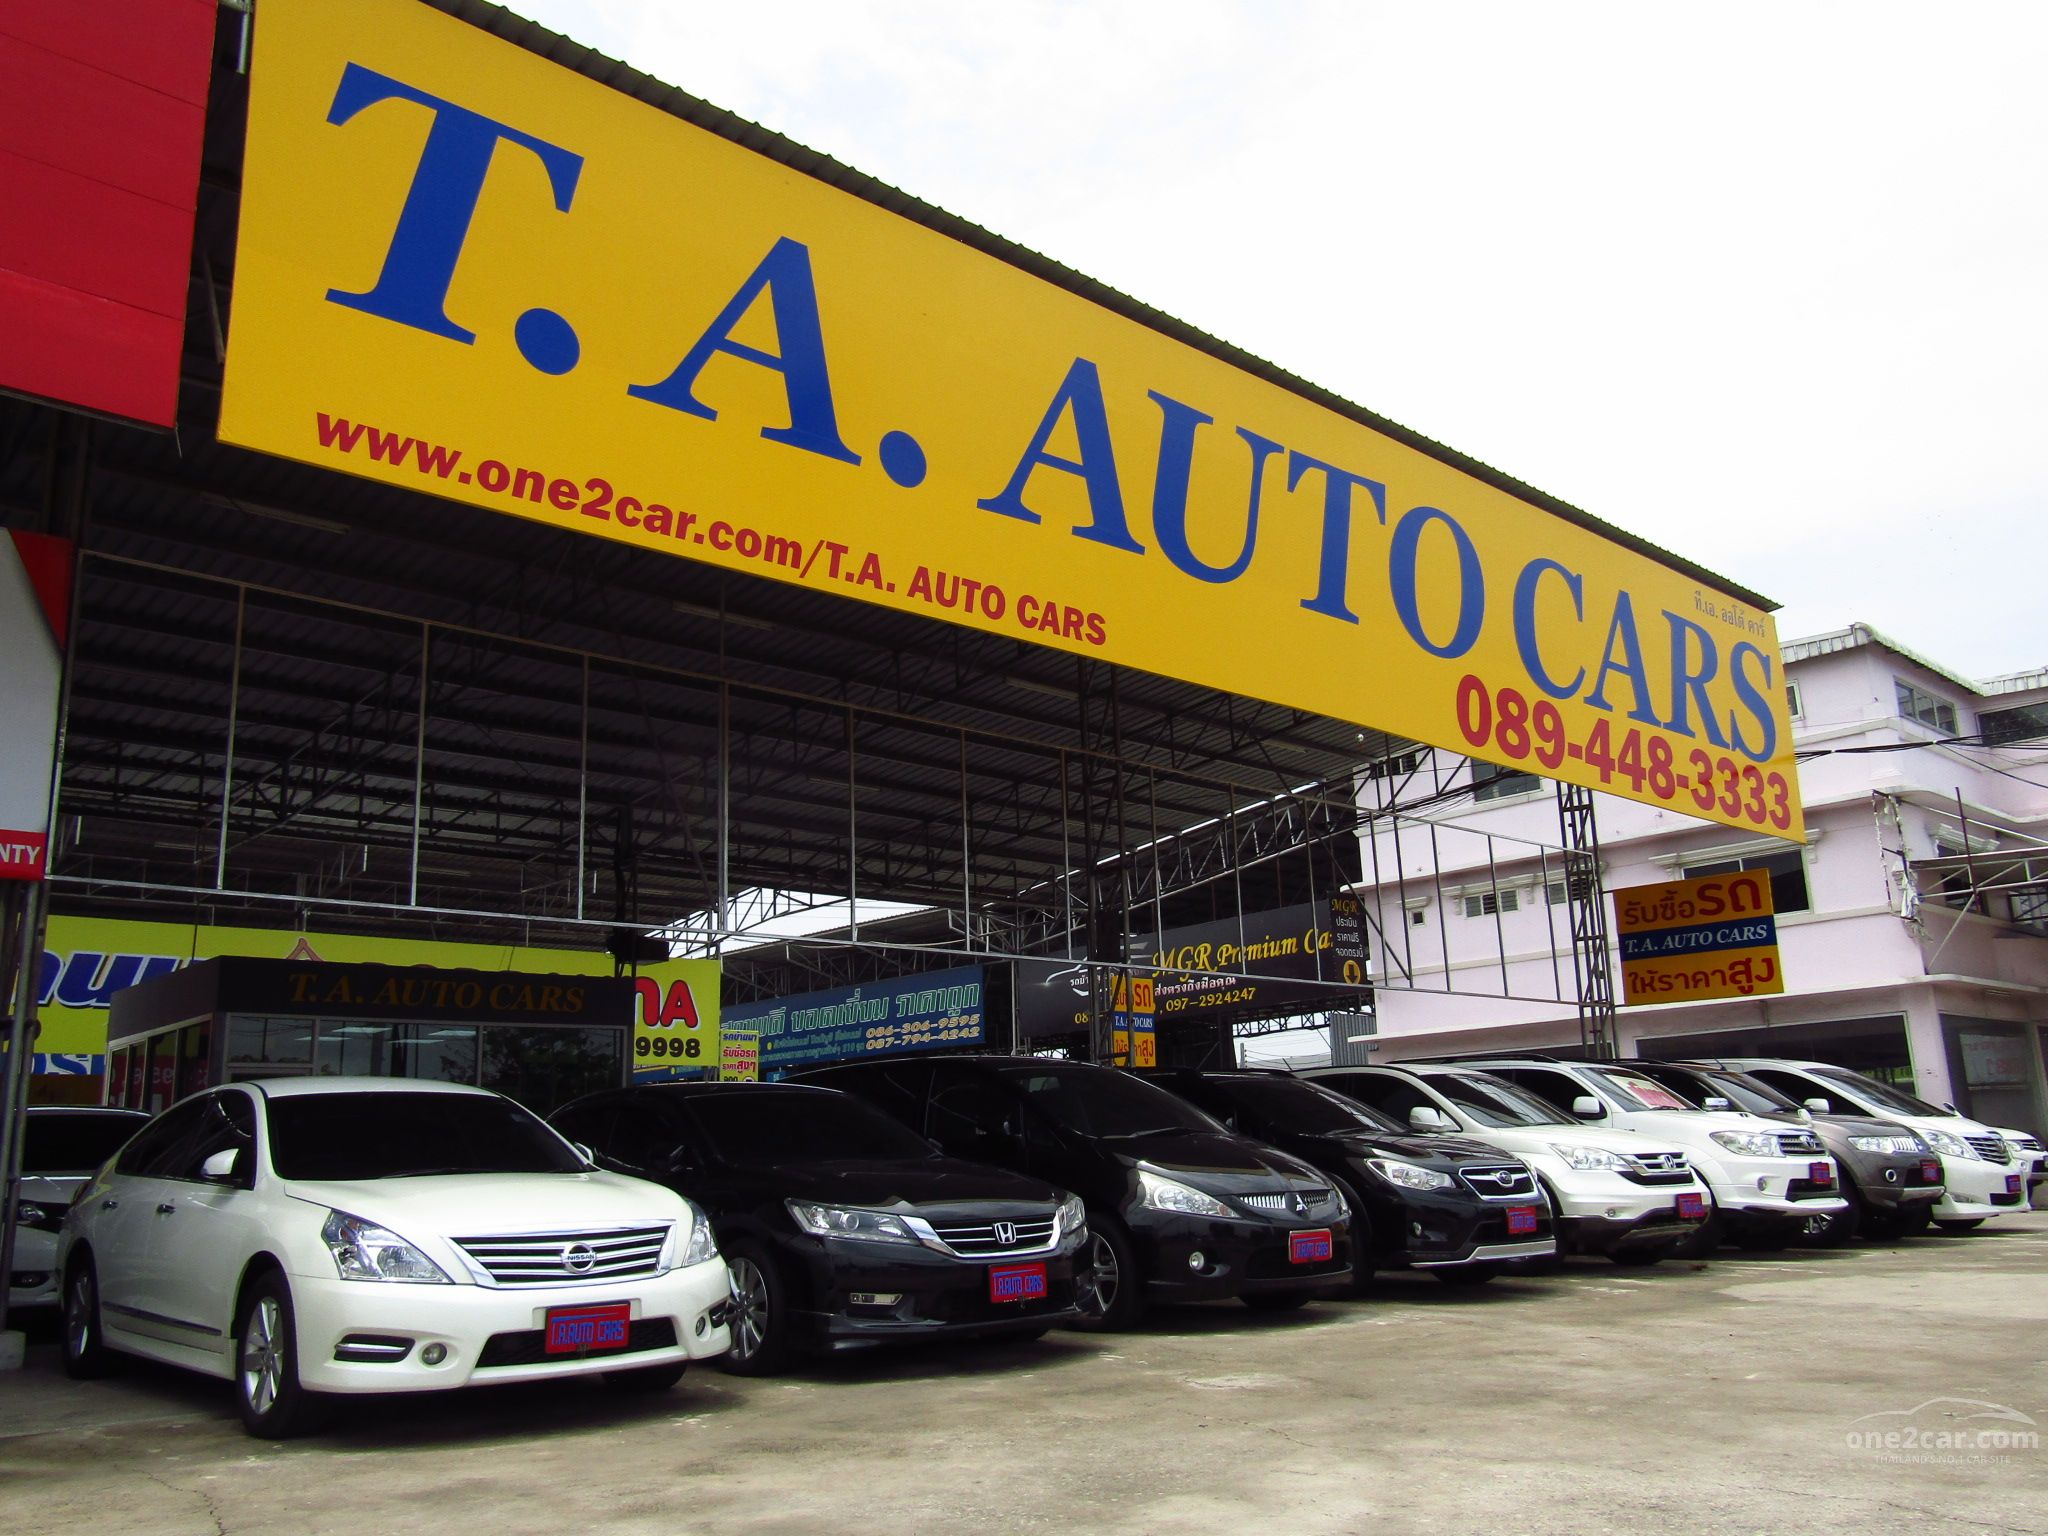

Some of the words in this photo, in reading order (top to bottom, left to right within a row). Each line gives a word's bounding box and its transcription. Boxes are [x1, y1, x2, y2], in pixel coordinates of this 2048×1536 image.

[316, 412, 896, 593] www.one2car.com/T.A.
[906, 566, 1006, 621] AUTO
[1016, 594, 1106, 646] CARS
[977, 357, 1485, 658] AUTO
[1513, 559, 1776, 764] CARS
[1456, 674, 1791, 831] 089-448-3333
[1217, 935, 1298, 966] Premium
[1304, 928, 1333, 954] Ca
[1663, 931, 1713, 950] AUTO
[1716, 924, 1768, 944] CARS
[1628, 957, 1775, 995] ให้ราคาสูง
[373, 977, 482, 1009] AUTO
[490, 984, 586, 1013] CARS
[896, 983, 979, 1017] ราคาถูก
[1165, 987, 1256, 1013] 097-2924247
[866, 1014, 980, 1039] 086-306-9595
[866, 1026, 980, 1050] 087-794-4242
[598, 1319, 625, 1342] CARS
